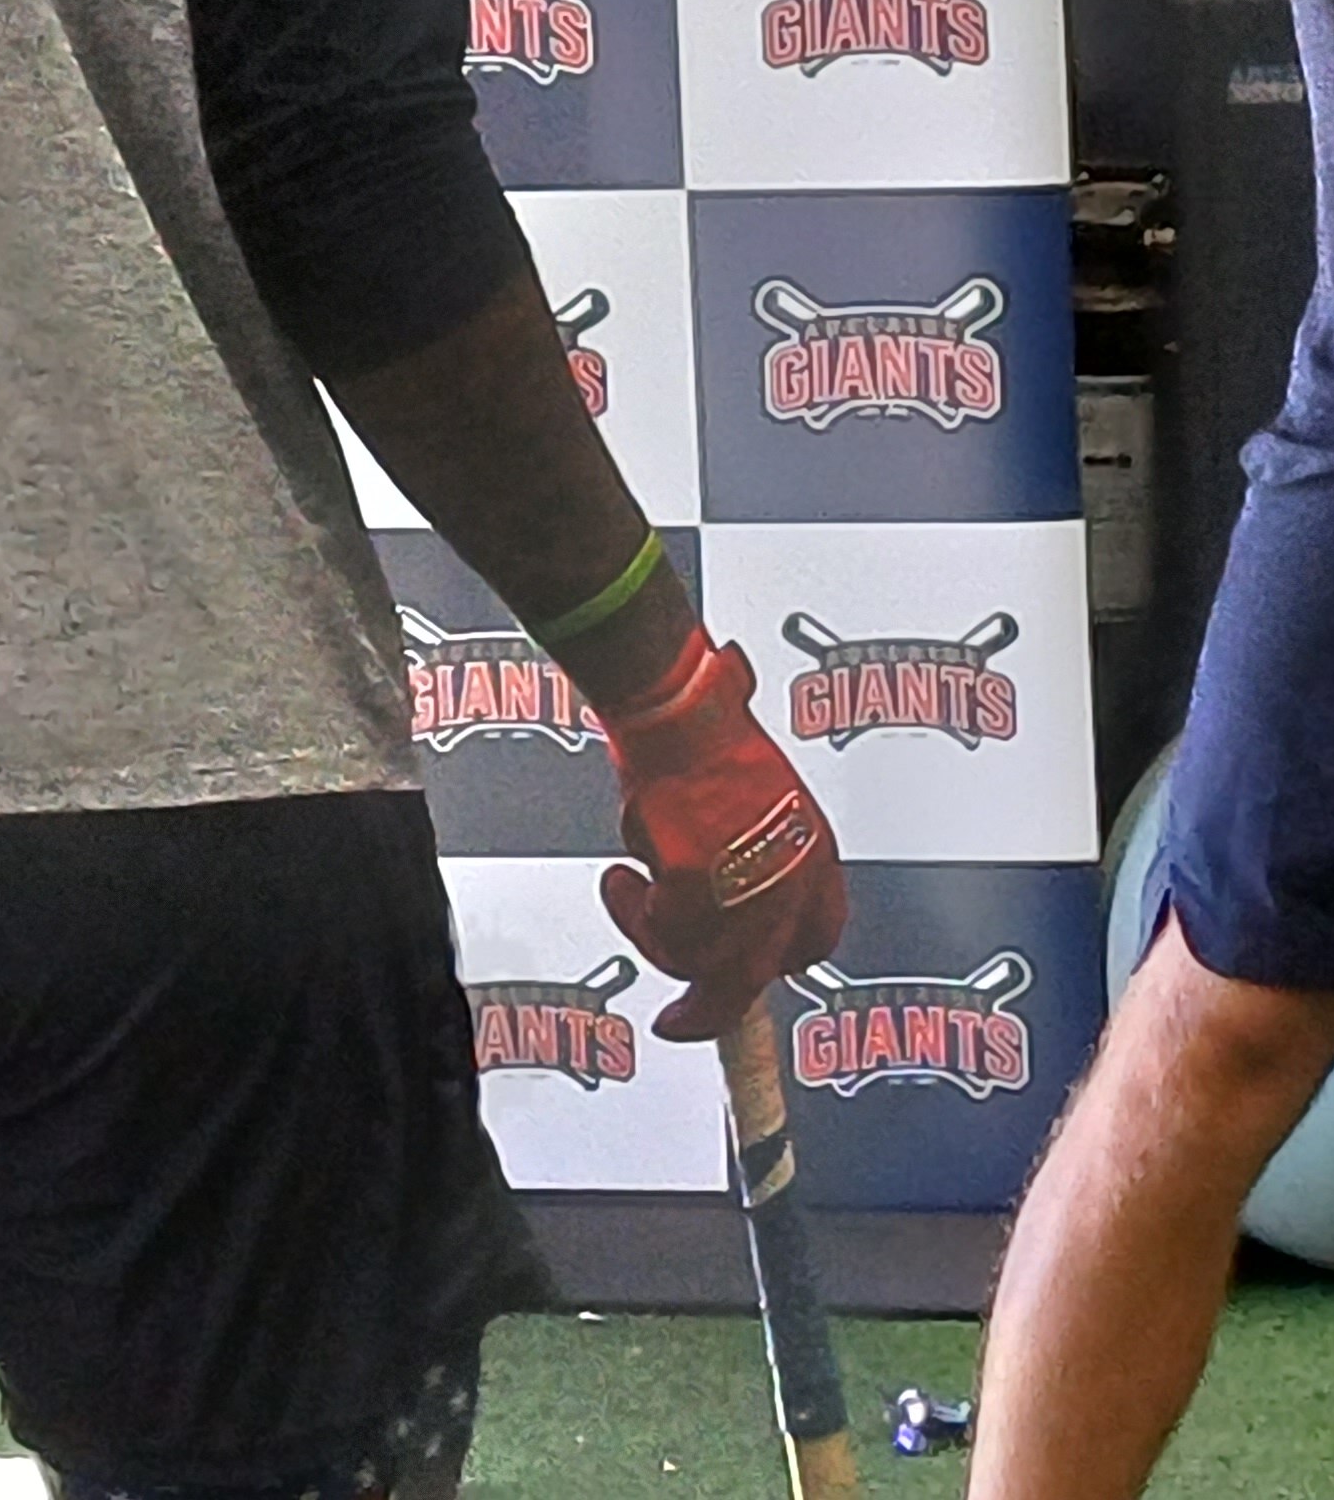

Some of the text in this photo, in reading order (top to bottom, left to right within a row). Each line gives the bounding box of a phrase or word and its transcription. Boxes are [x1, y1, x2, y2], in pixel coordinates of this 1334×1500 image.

[771, 334, 995, 411] GIANTS
[790, 662, 1016, 741] GIANTS
[475, 1003, 636, 1082] ANTS
[798, 1006, 1023, 1082] GIANTS
